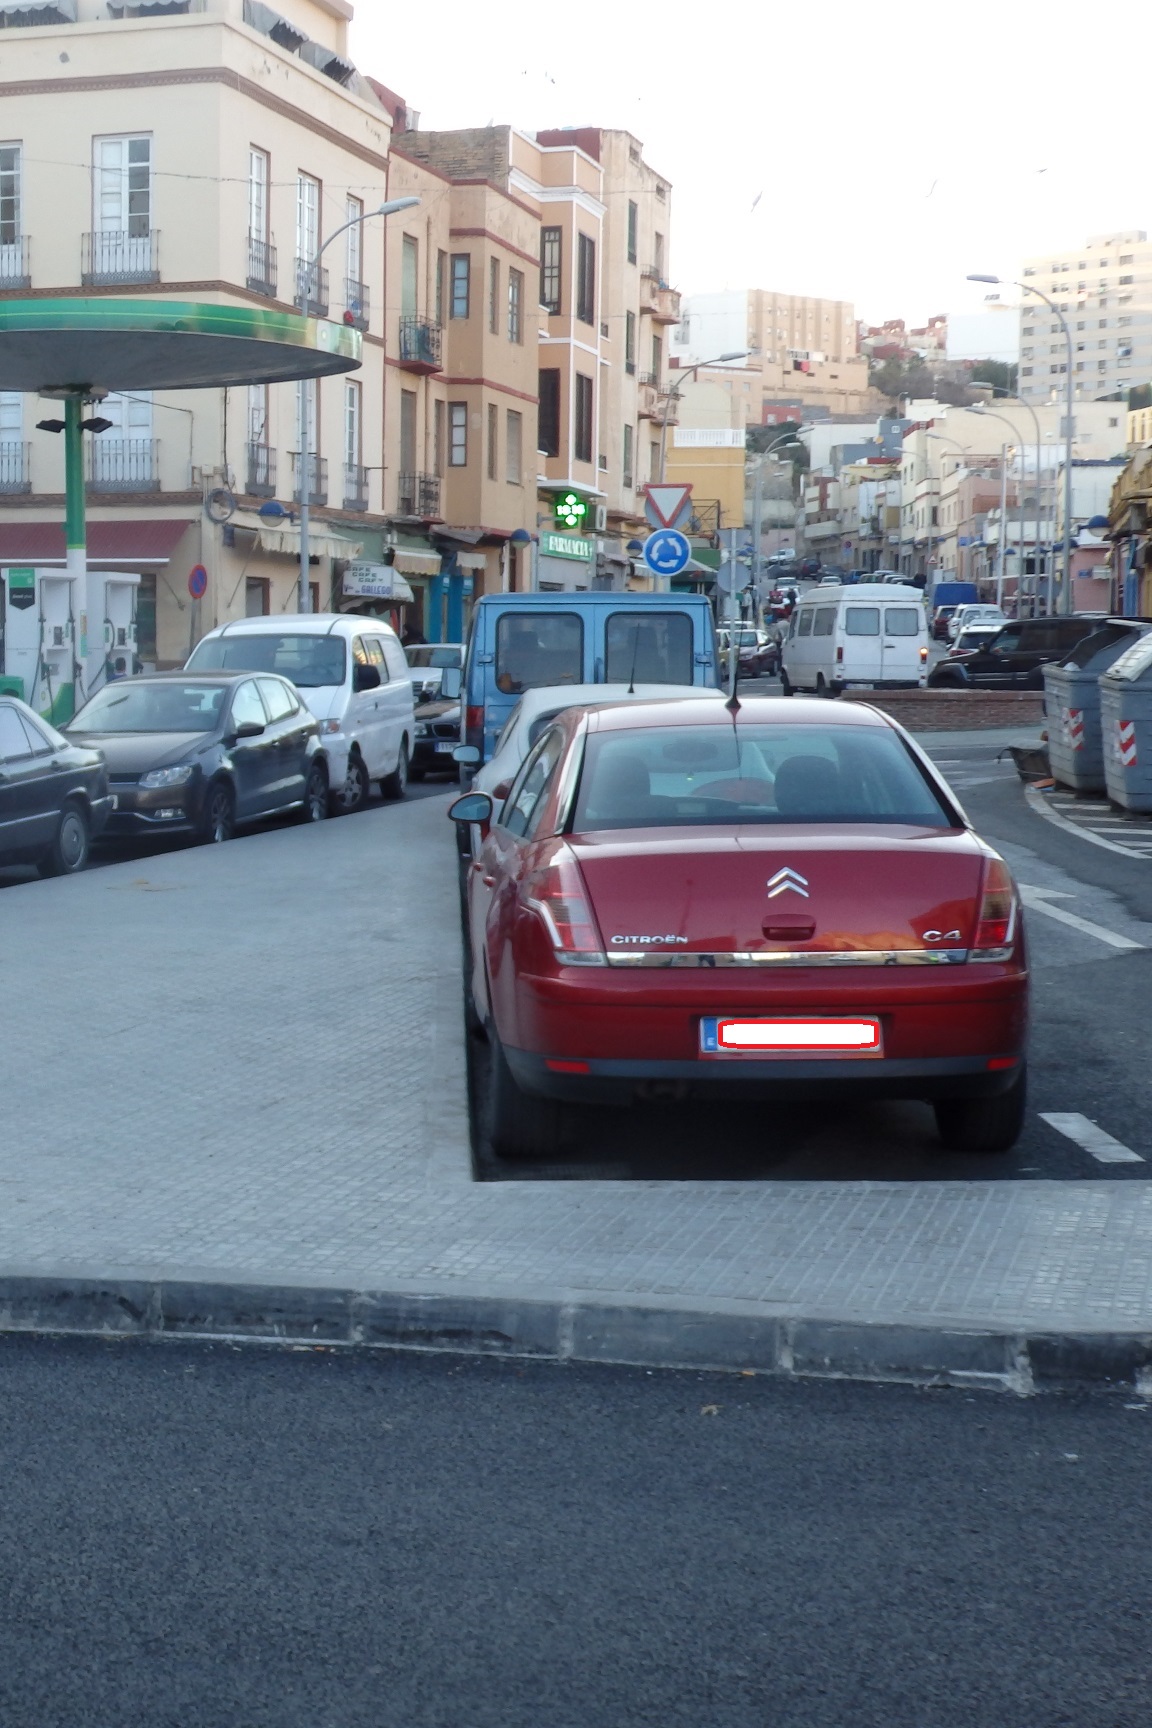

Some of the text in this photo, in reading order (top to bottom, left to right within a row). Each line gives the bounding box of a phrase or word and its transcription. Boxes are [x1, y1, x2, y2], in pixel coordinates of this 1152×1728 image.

[549, 536, 589, 556] FARMACIA
[611, 934, 688, 944] CITROËN
[922, 930, 962, 941] C4
